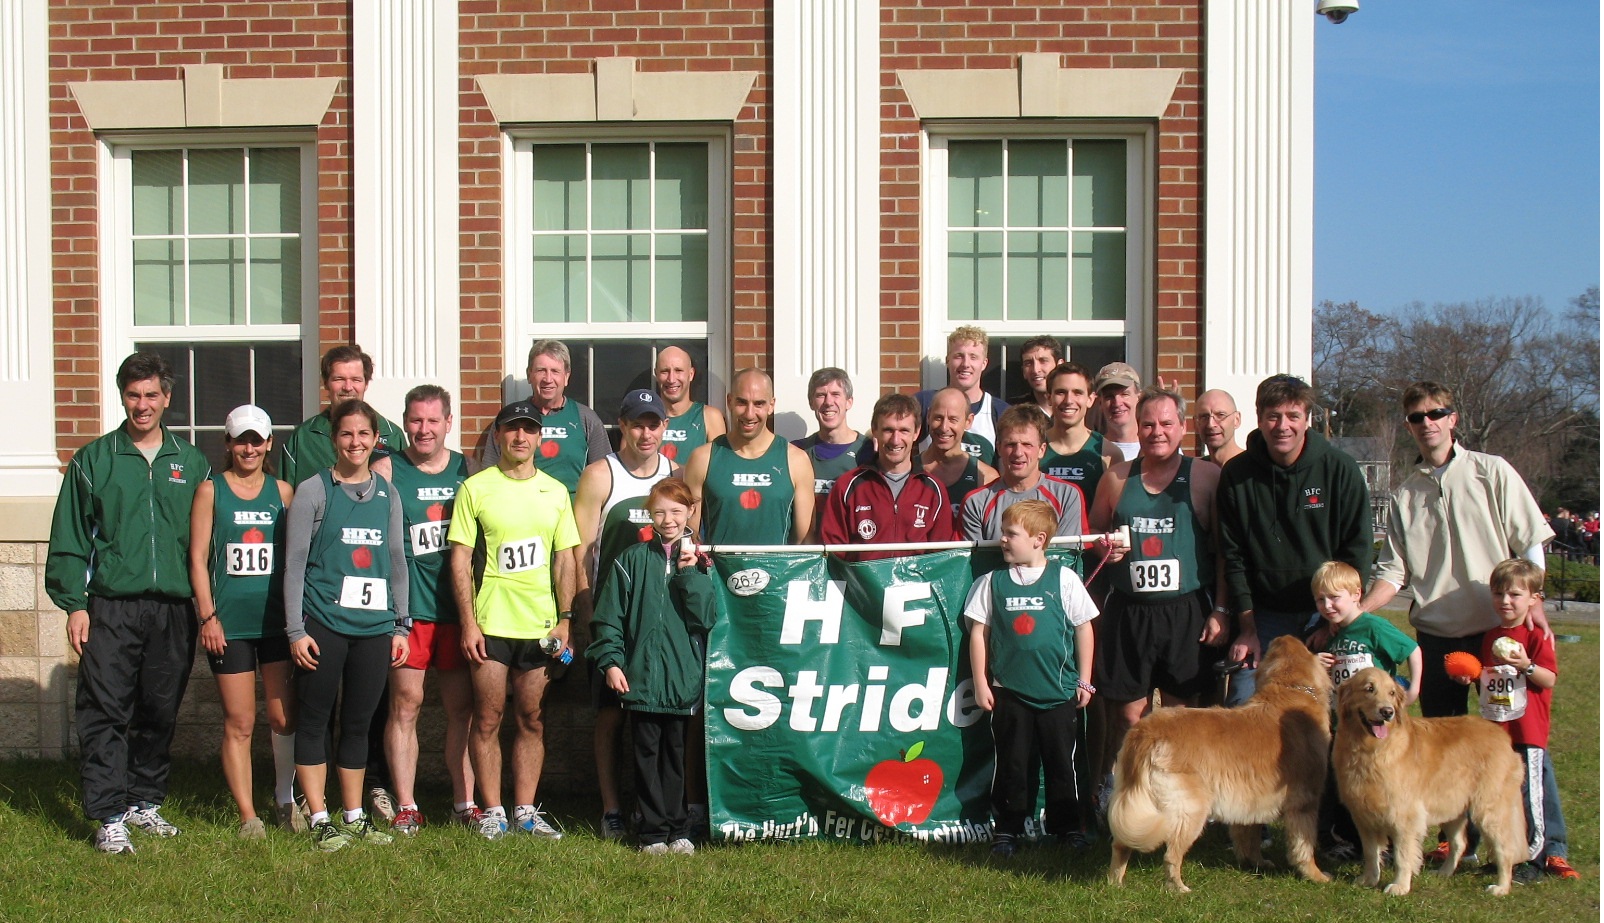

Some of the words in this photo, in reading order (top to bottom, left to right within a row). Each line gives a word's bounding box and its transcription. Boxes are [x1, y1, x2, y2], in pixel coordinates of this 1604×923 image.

[961, 443, 981, 453] FC
[732, 473, 771, 483] HFC
[1048, 467, 1084, 476] HFC
[417, 487, 455, 497] HFC
[1305, 488, 1321, 496] HFC
[234, 511, 272, 521] HFC
[1132, 516, 1174, 528] HFC
[341, 527, 382, 540] HFC
[419, 523, 450, 549] 467
[232, 547, 269, 572] 316
[503, 543, 537, 570] 317
[731, 571, 762, 590] 26.2
[1136, 564, 1172, 588] 393
[361, 582, 372, 606] 5
[1005, 596, 1044, 607] HFC
[780, 580, 847, 645] H
[879, 582, 932, 646] F
[1334, 668, 1359, 685] 89
[1487, 678, 1514, 693] 890
[722, 823, 756, 842] The
[762, 812, 819, 840] Hurt'n
[825, 810, 855, 839] Fer
[933, 819, 995, 844] strider
